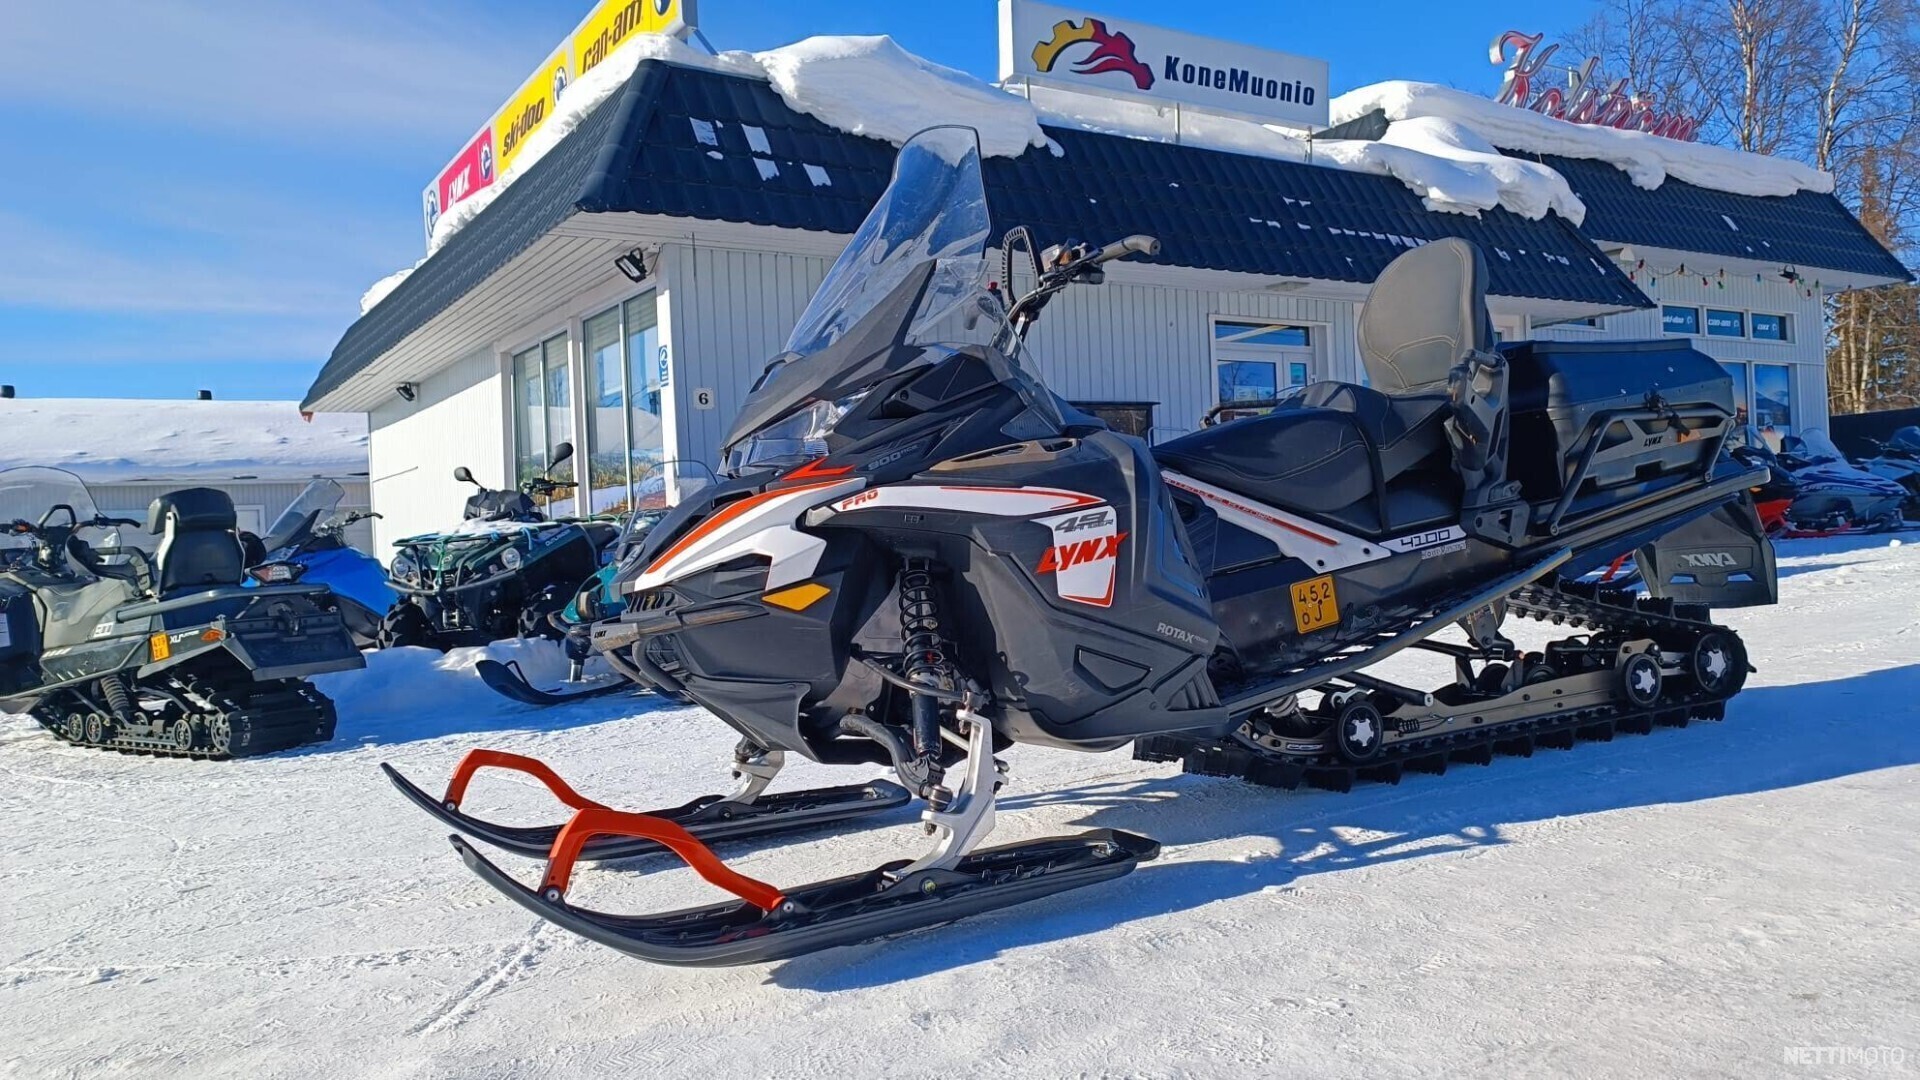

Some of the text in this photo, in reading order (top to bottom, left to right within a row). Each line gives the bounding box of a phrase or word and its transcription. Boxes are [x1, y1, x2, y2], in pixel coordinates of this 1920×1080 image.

[582, 0, 642, 74] can-am
[1165, 55, 1315, 106] KoneMuonio
[503, 97, 545, 157] ski-doo
[447, 163, 472, 208] LYNX
[698, 392, 709, 405] 6
[1643, 436, 1664, 447] LYNX
[867, 451, 901, 471] 900
[842, 489, 879, 510] PRO
[1055, 510, 1108, 533] 49
[1400, 529, 1451, 548] 4100
[1035, 532, 1129, 573] LYNX
[1298, 582, 1331, 604] 452
[1156, 622, 1195, 644] ROTAX
